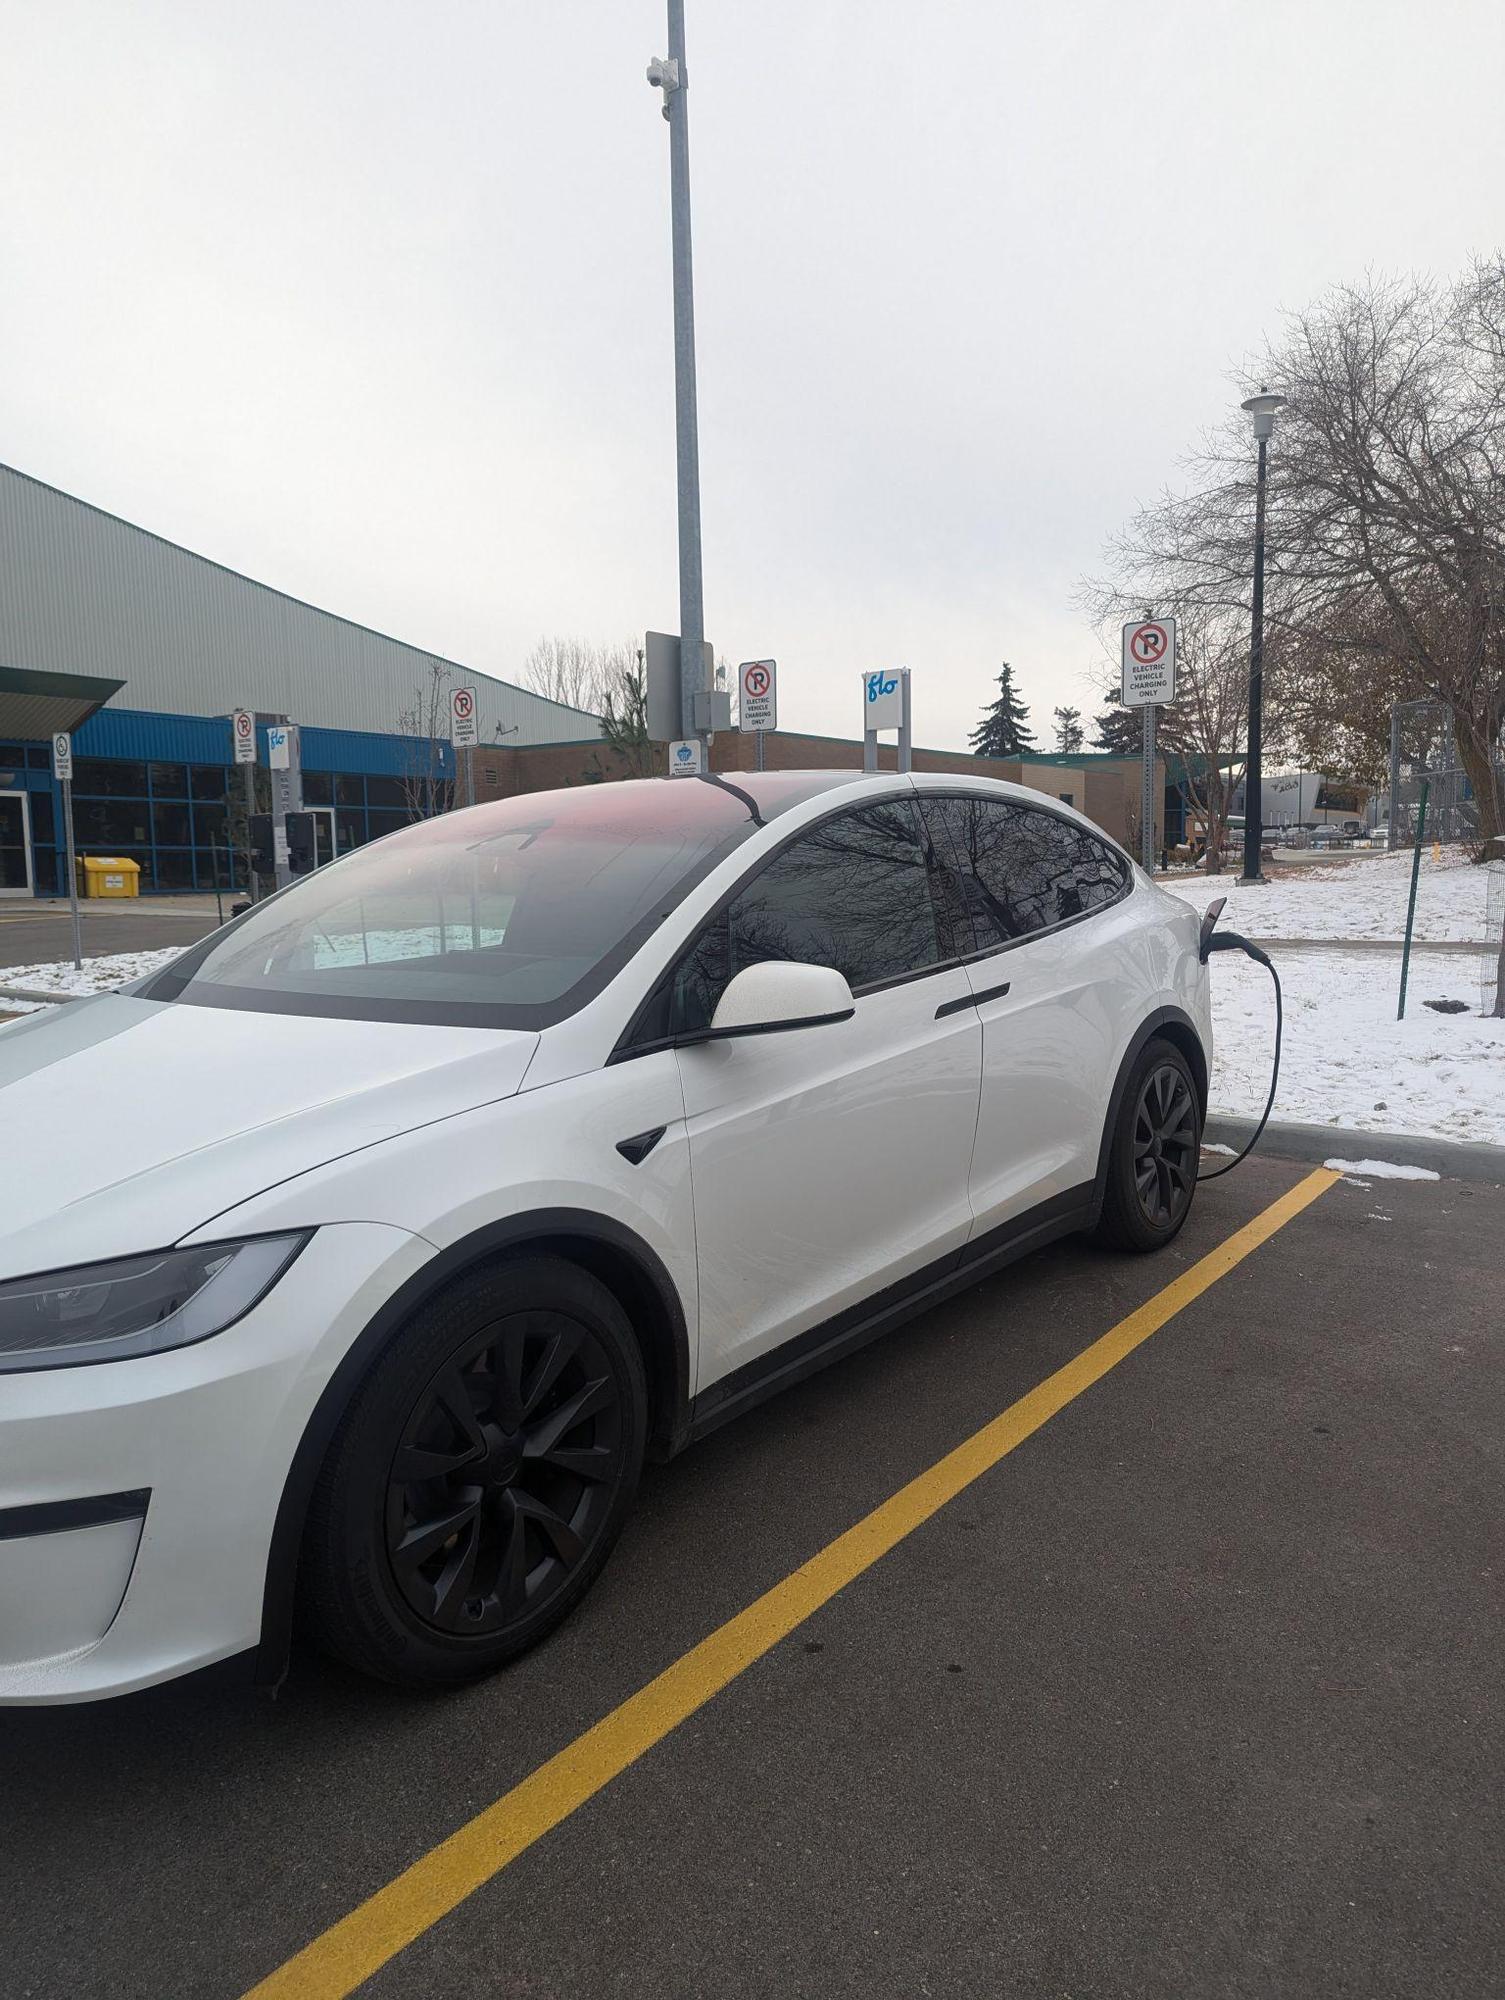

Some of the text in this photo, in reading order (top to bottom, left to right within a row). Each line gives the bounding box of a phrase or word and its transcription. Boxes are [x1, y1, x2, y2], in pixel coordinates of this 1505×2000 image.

[1143, 633, 1159, 655] P
[1132, 663, 1165, 673] ELECTRIC
[754, 673, 764, 690] P
[1133, 672, 1163, 681] VEHICLE
[867, 671, 898, 702] flo
[1129, 680, 1167, 690] CHARGING
[1138, 690, 1158, 698] ONLY
[745, 711, 771, 719] CHARGING
[270, 729, 285, 749] flo
